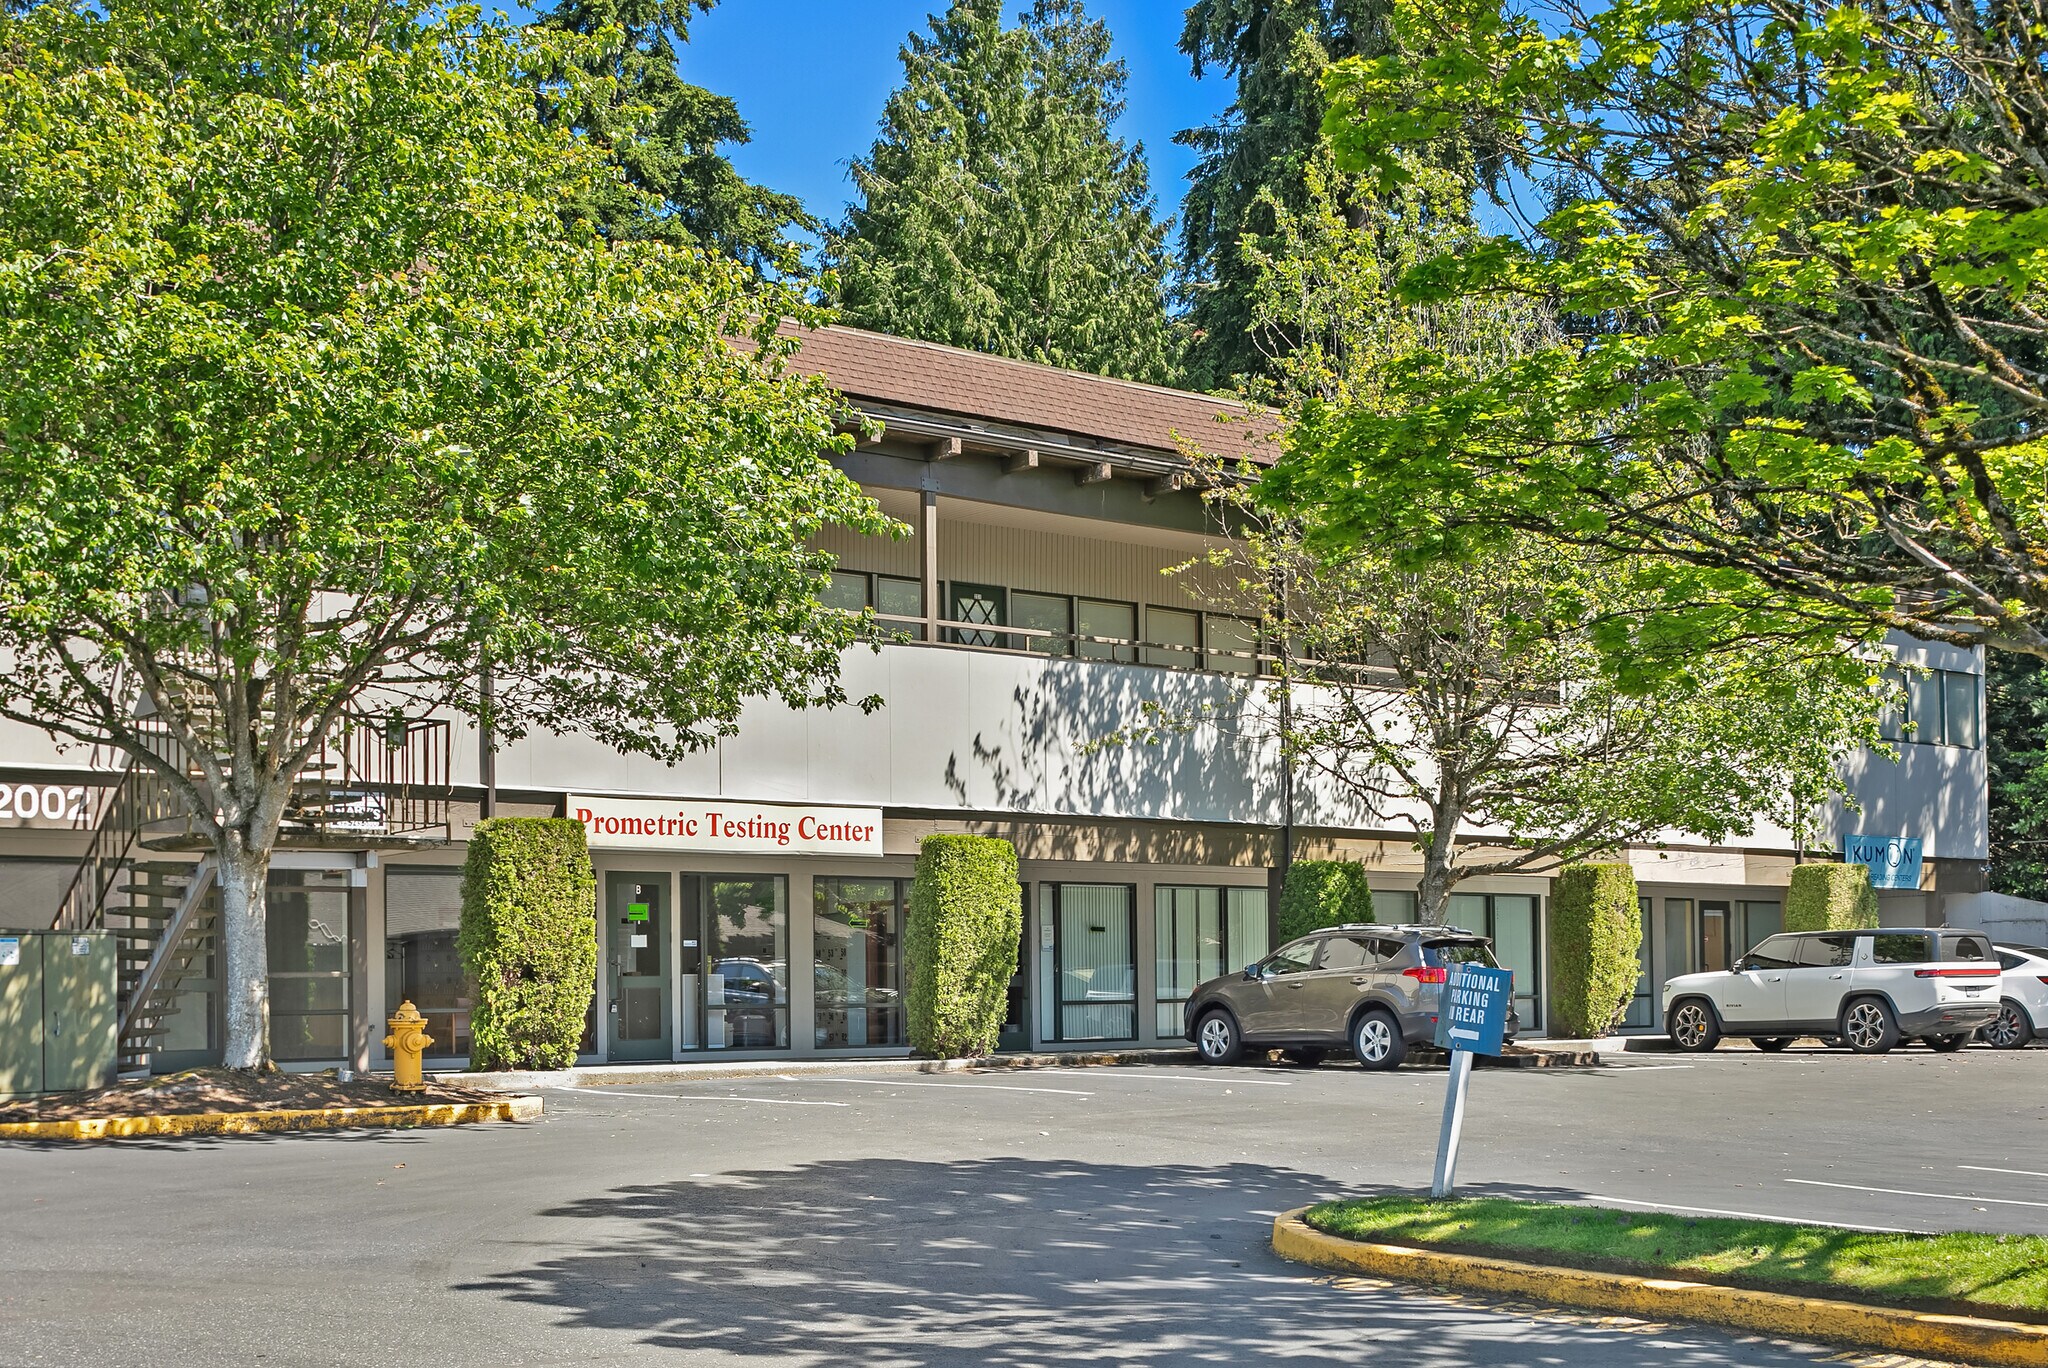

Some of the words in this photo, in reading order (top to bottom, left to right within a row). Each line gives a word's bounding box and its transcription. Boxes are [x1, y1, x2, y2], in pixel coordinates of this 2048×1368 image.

[0, 784, 90, 820] 2002
[576, 808, 698, 836] Prometric
[705, 813, 791, 846] Testing
[798, 815, 874, 842] Center
[1853, 843, 1913, 867] KUMON
[1450, 988, 1489, 1008] PARKING
[1455, 1006, 1485, 1025] REAR
